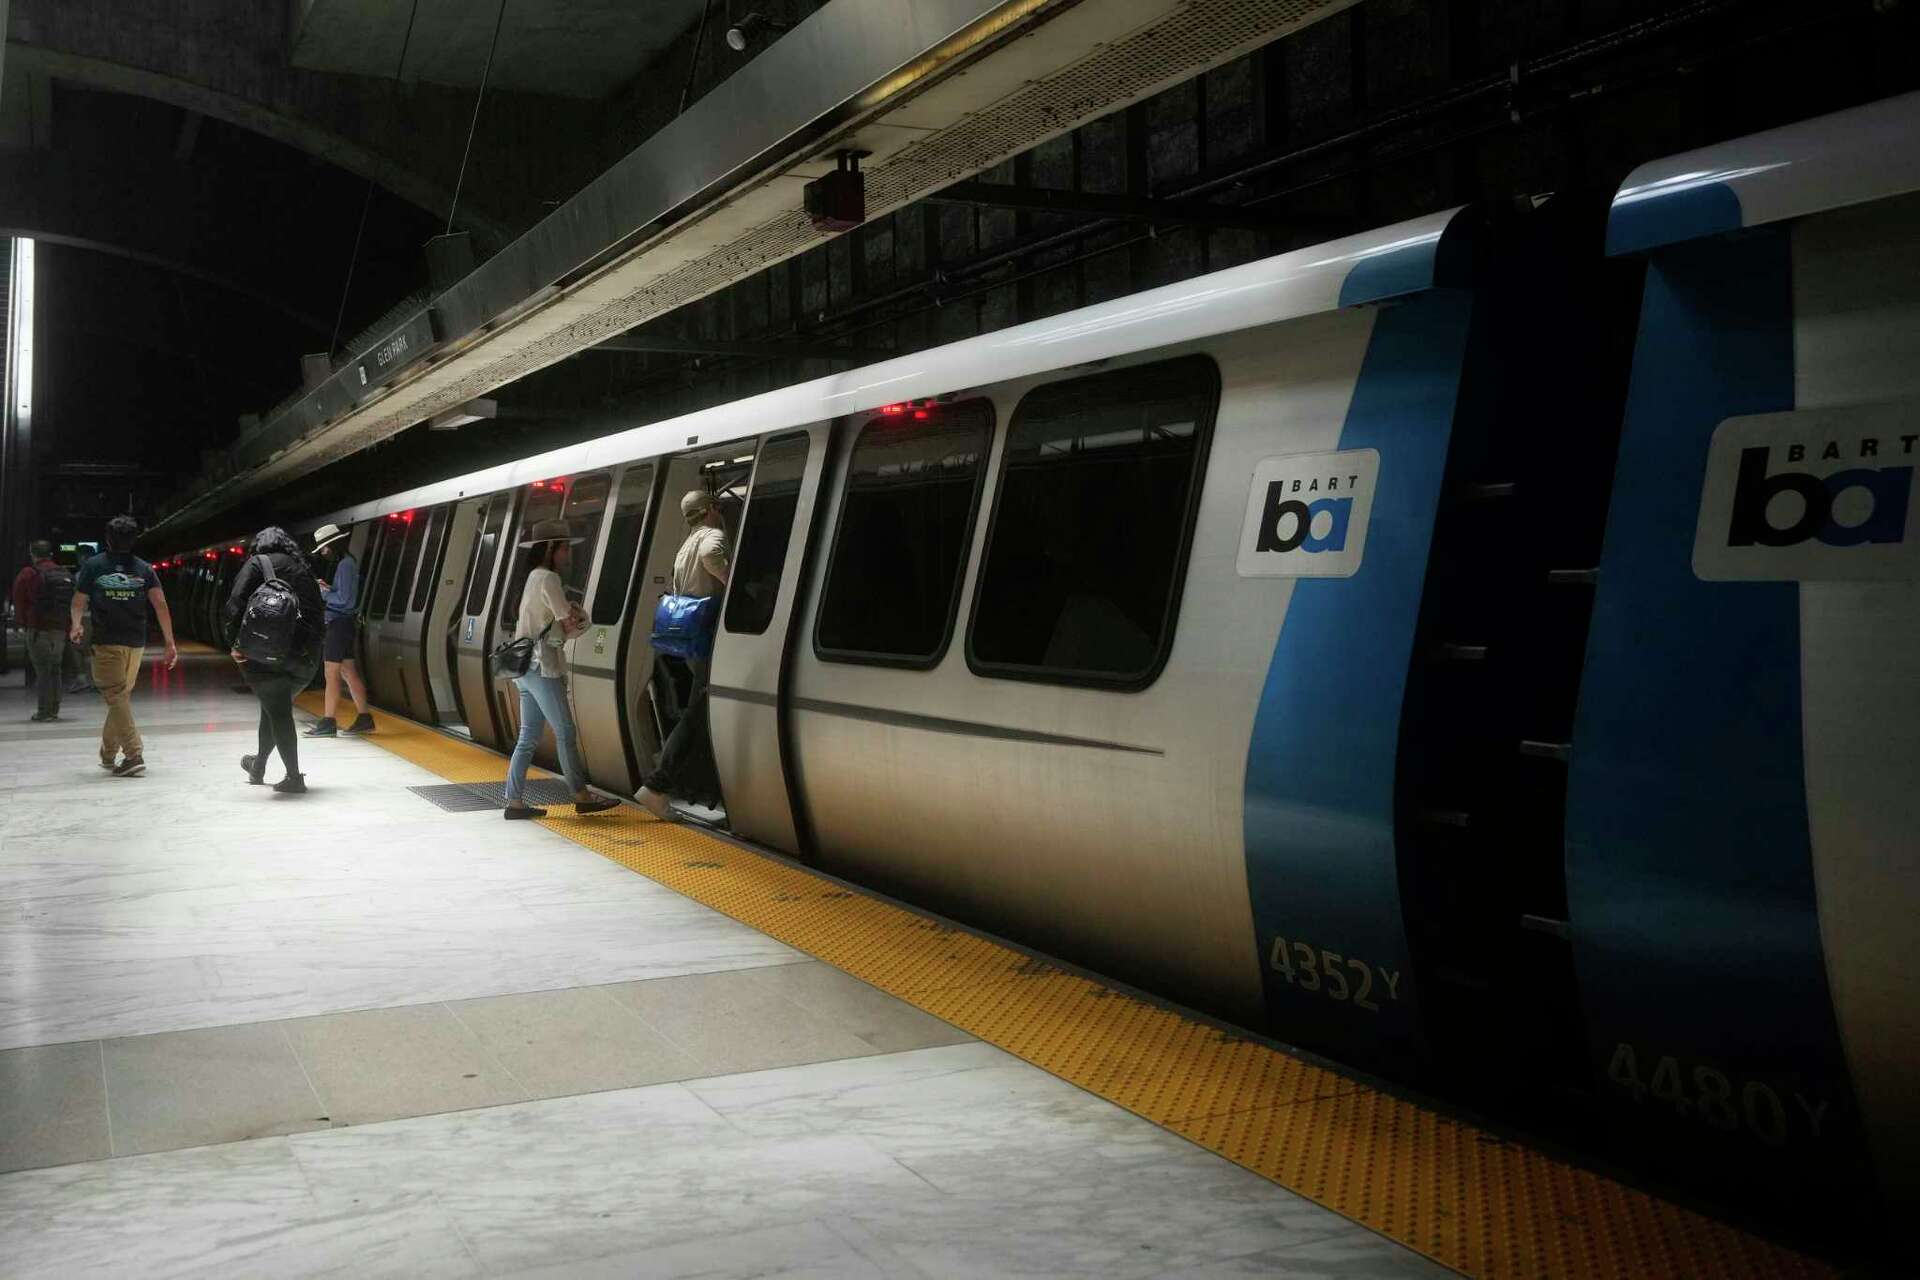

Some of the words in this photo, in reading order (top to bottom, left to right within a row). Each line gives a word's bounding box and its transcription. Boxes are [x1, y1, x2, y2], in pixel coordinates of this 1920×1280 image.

[377, 346, 393, 367] GLEN
[391, 334, 409, 360] PARK
[1787, 435, 1919, 462] BART
[1292, 475, 1358, 492] BART
